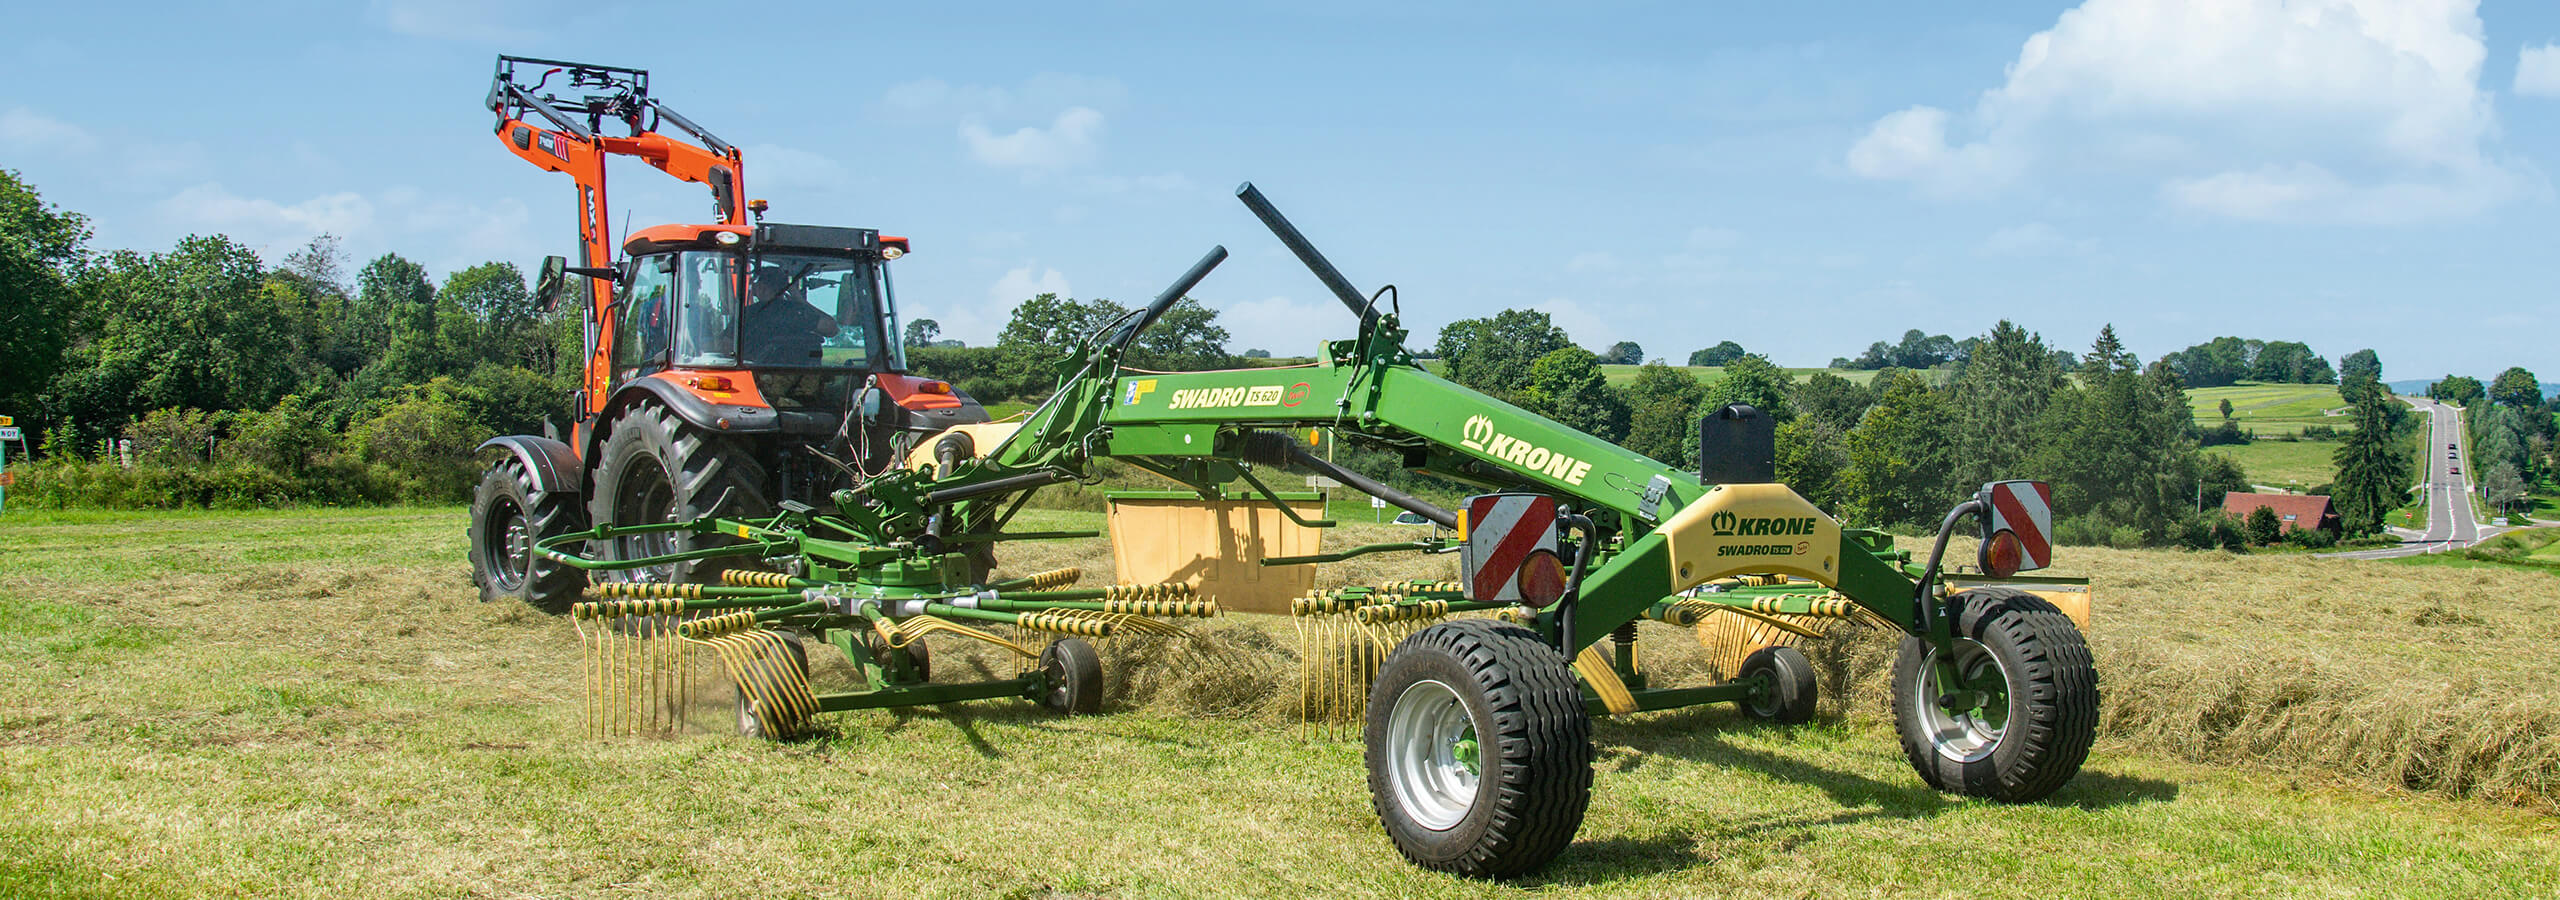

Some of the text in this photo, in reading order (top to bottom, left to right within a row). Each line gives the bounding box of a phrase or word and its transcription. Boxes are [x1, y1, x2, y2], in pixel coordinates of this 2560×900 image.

[587, 190, 596, 226] MX
[1169, 387, 1246, 409] SWADRO
[1250, 391, 1261, 402] TS
[1261, 390, 1279, 402] 620
[1486, 433, 1592, 487] KRONE
[1737, 518, 1816, 536] KRONE
[1717, 545, 1769, 556] SWADRO
